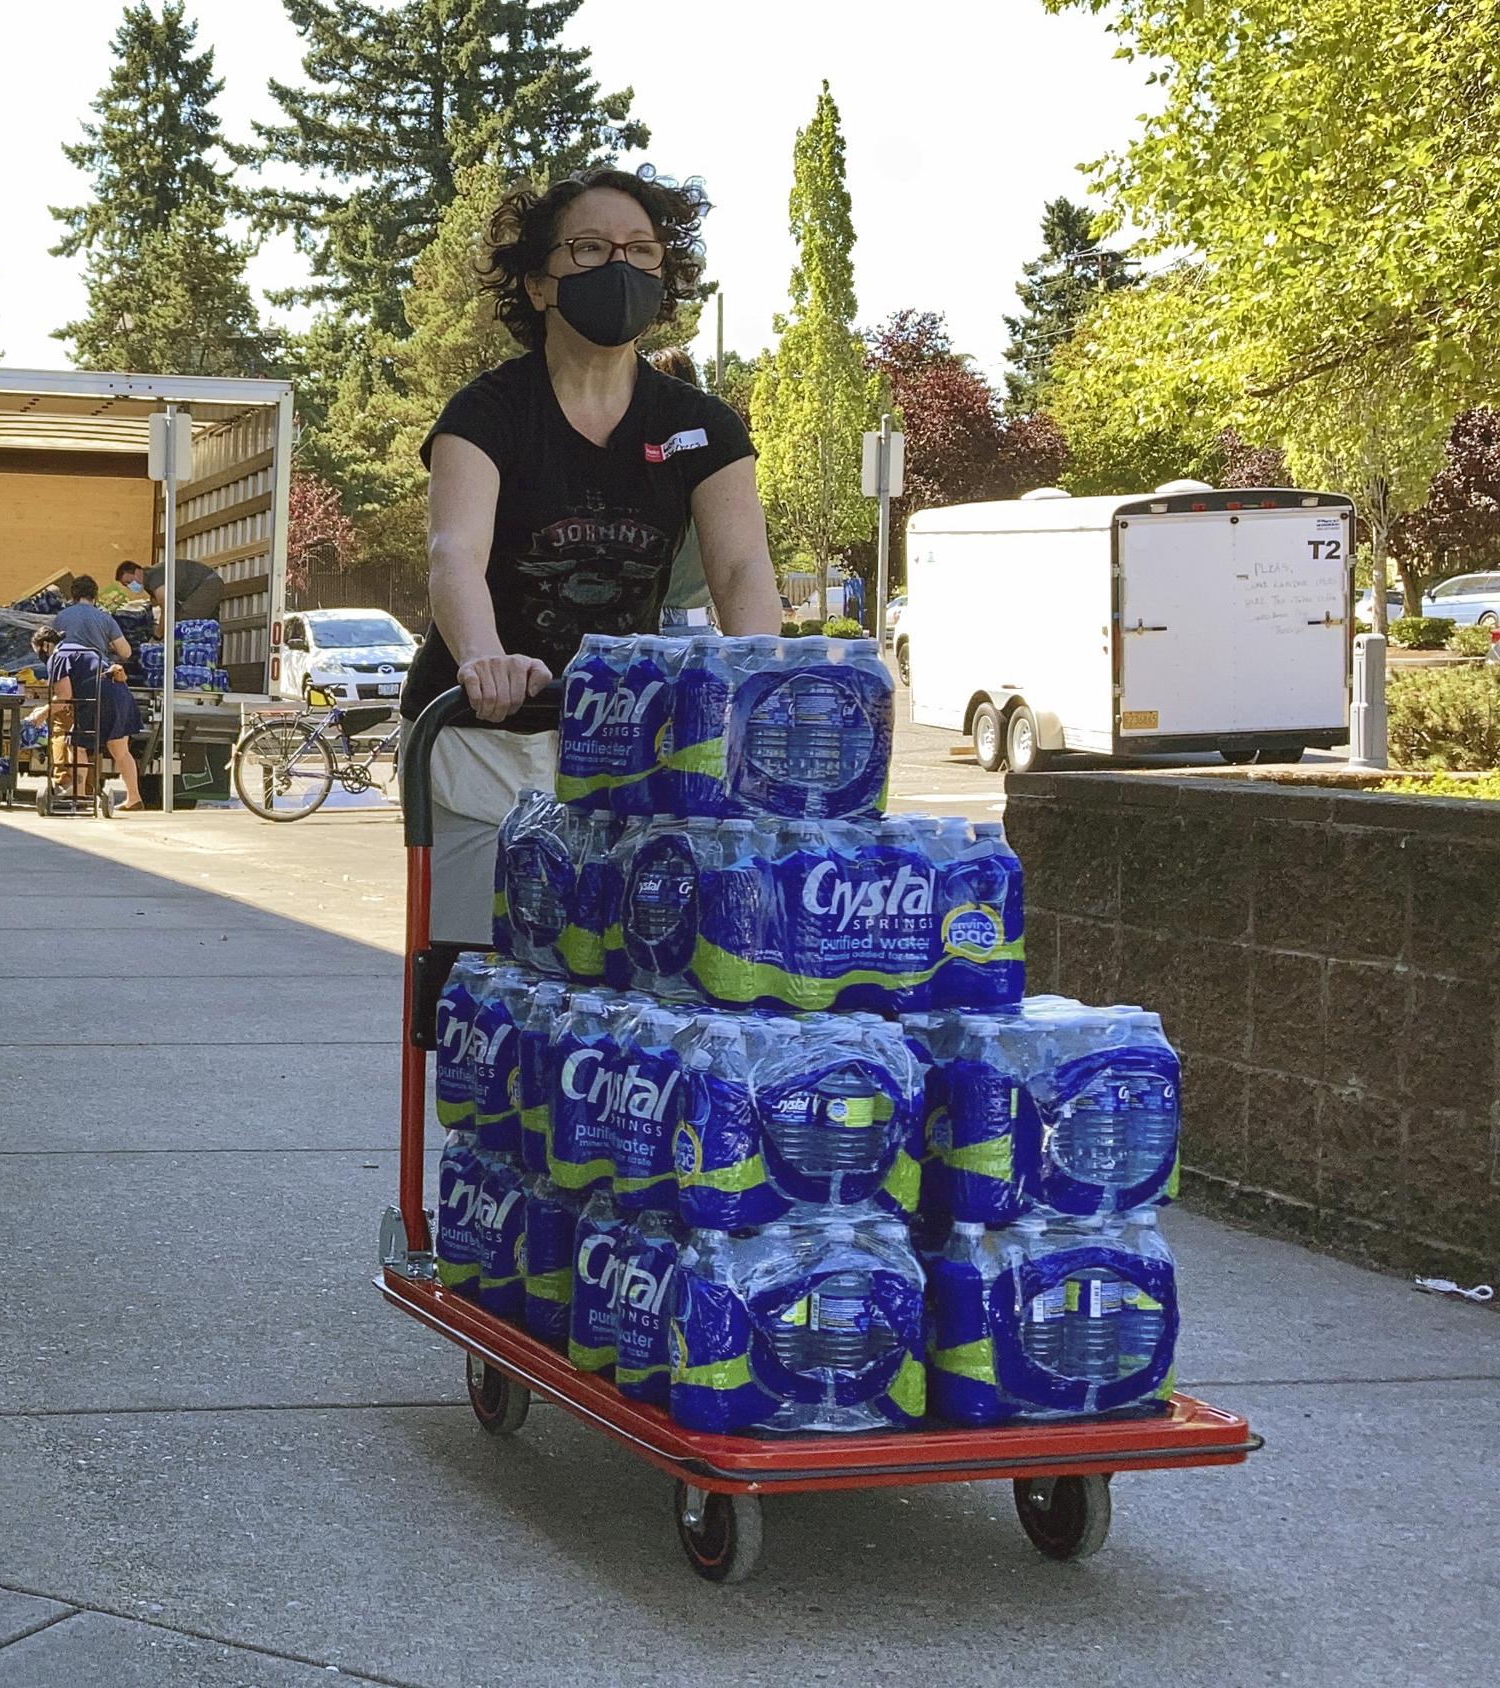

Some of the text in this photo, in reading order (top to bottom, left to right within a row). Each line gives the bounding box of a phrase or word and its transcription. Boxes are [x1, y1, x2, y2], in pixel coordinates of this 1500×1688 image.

[552, 524, 658, 548] JOHNNY
[1307, 540, 1341, 560] T2
[564, 671, 665, 737] Cryal
[802, 860, 936, 932] Crystal
[951, 918, 993, 931] enviro
[820, 934, 873, 955] purified
[951, 929, 998, 947] pac
[436, 999, 512, 1066] Cryal
[616, 1138, 656, 1157] ater
[440, 1160, 521, 1230] Cryal
